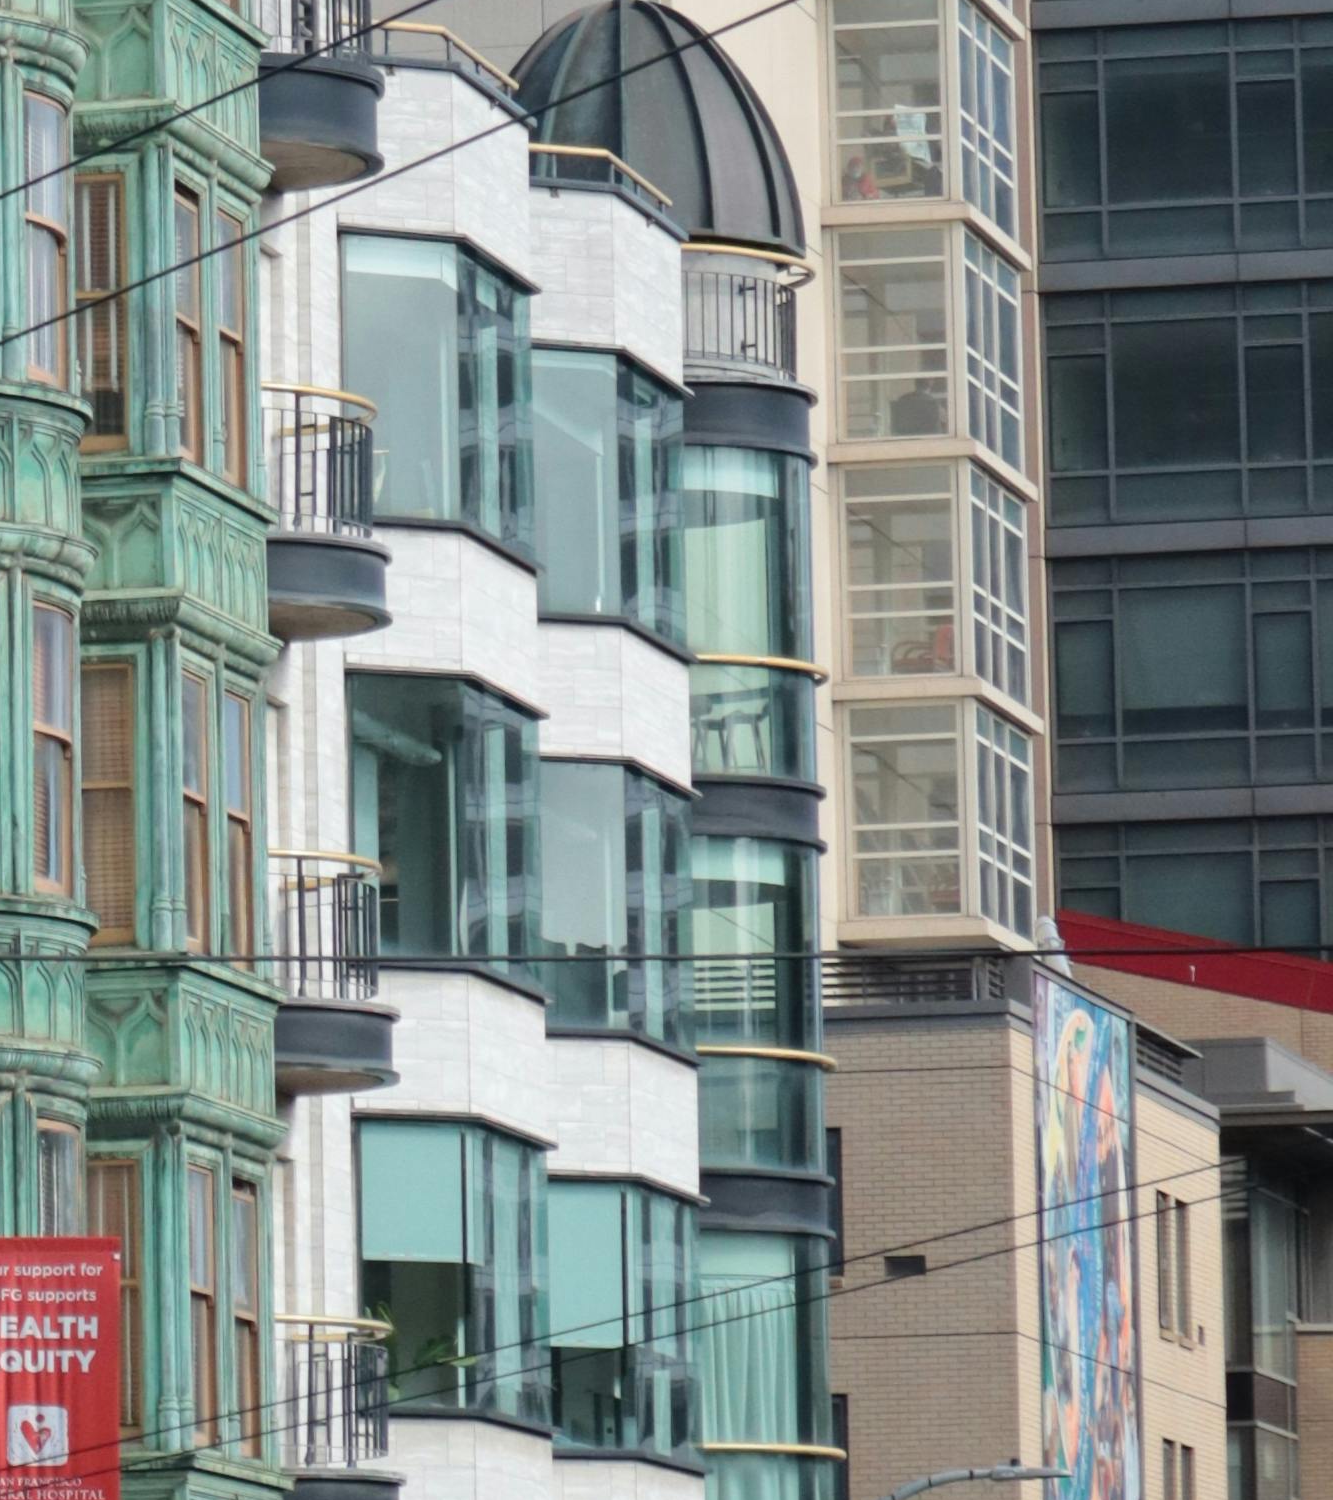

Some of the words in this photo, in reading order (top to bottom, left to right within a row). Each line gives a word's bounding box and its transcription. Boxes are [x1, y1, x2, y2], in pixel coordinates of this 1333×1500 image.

[14, 1264, 76, 1279] support
[80, 1263, 104, 1276] for
[26, 1288, 98, 1303] supports
[36, 1488, 106, 1500] HOSPITAL
